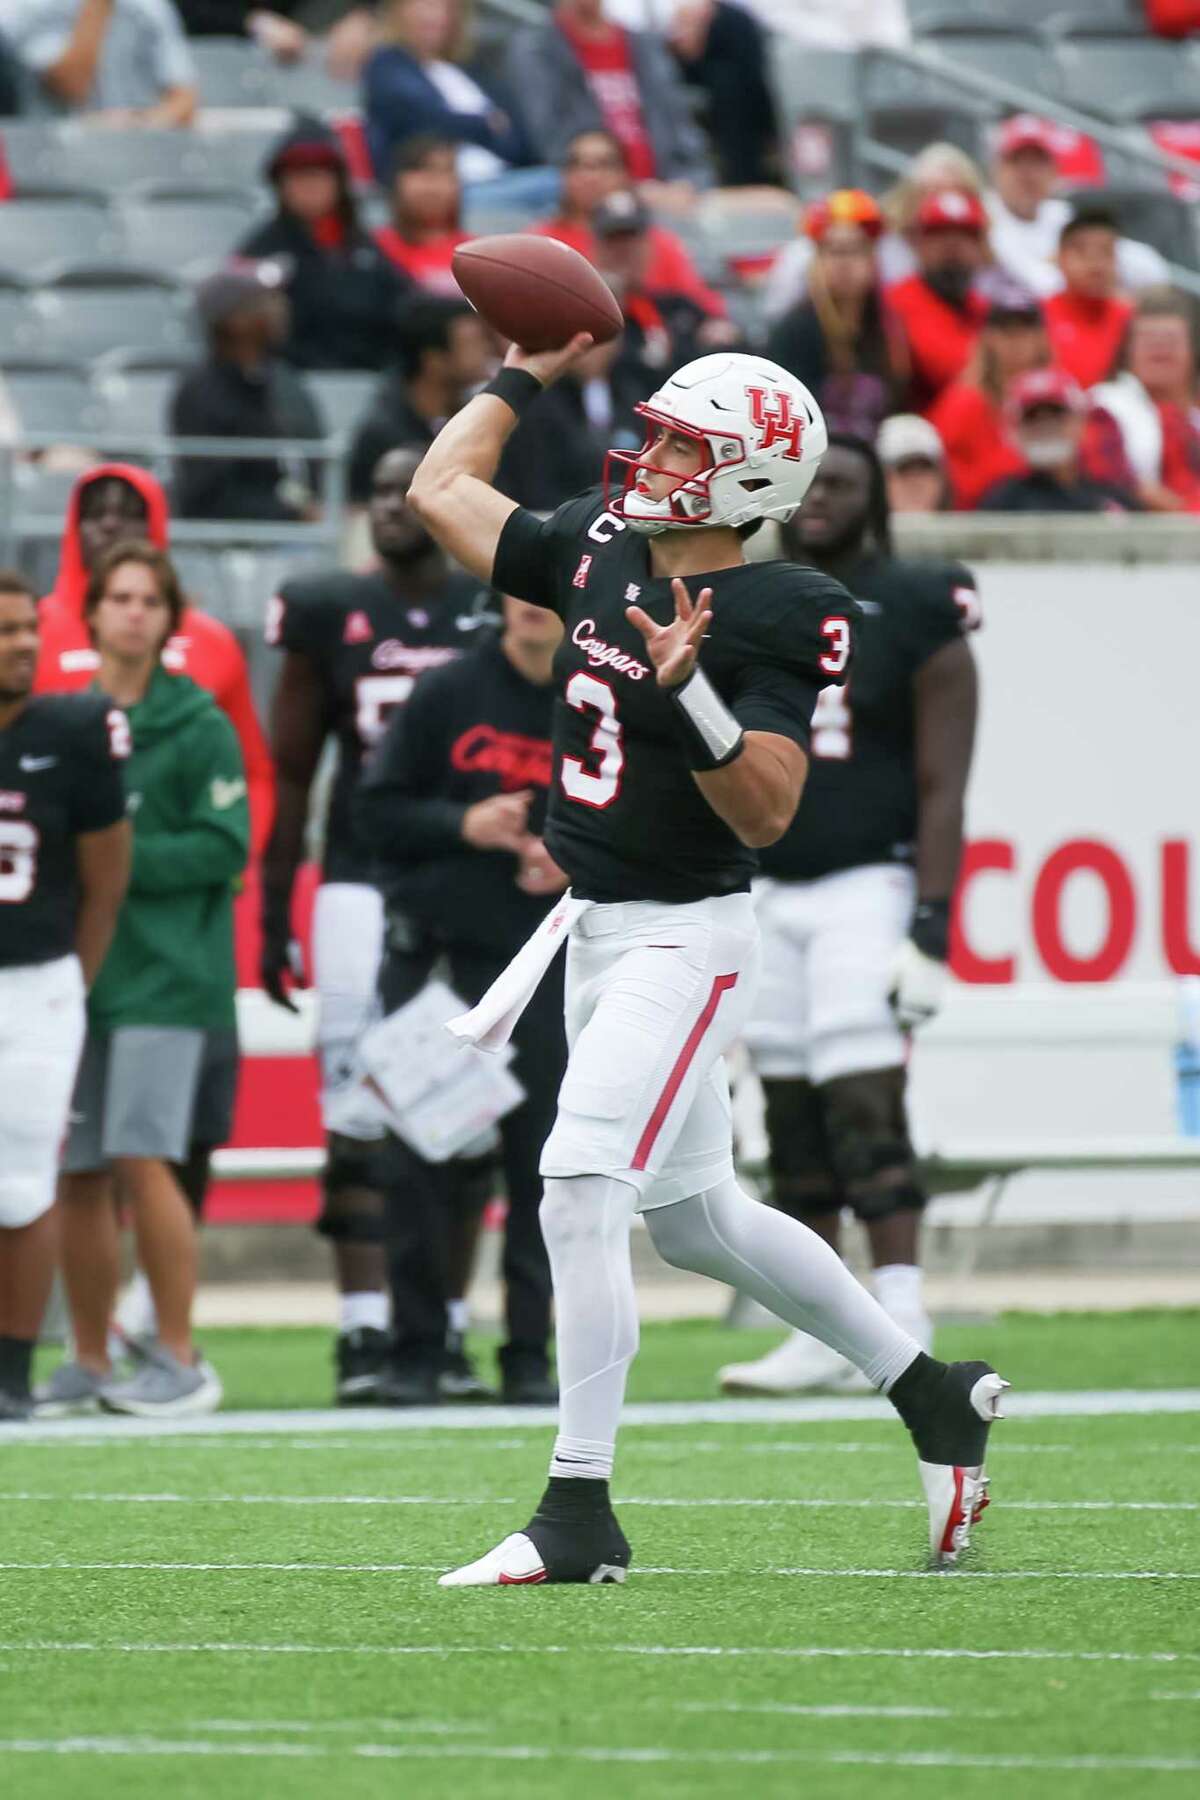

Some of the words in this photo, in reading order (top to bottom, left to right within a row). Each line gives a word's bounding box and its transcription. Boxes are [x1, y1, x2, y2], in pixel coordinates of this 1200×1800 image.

[745, 385, 806, 462] UH
[588, 512, 626, 543] C
[571, 619, 650, 680] Cougars
[819, 616, 851, 675] 3
[561, 670, 625, 810] 3
